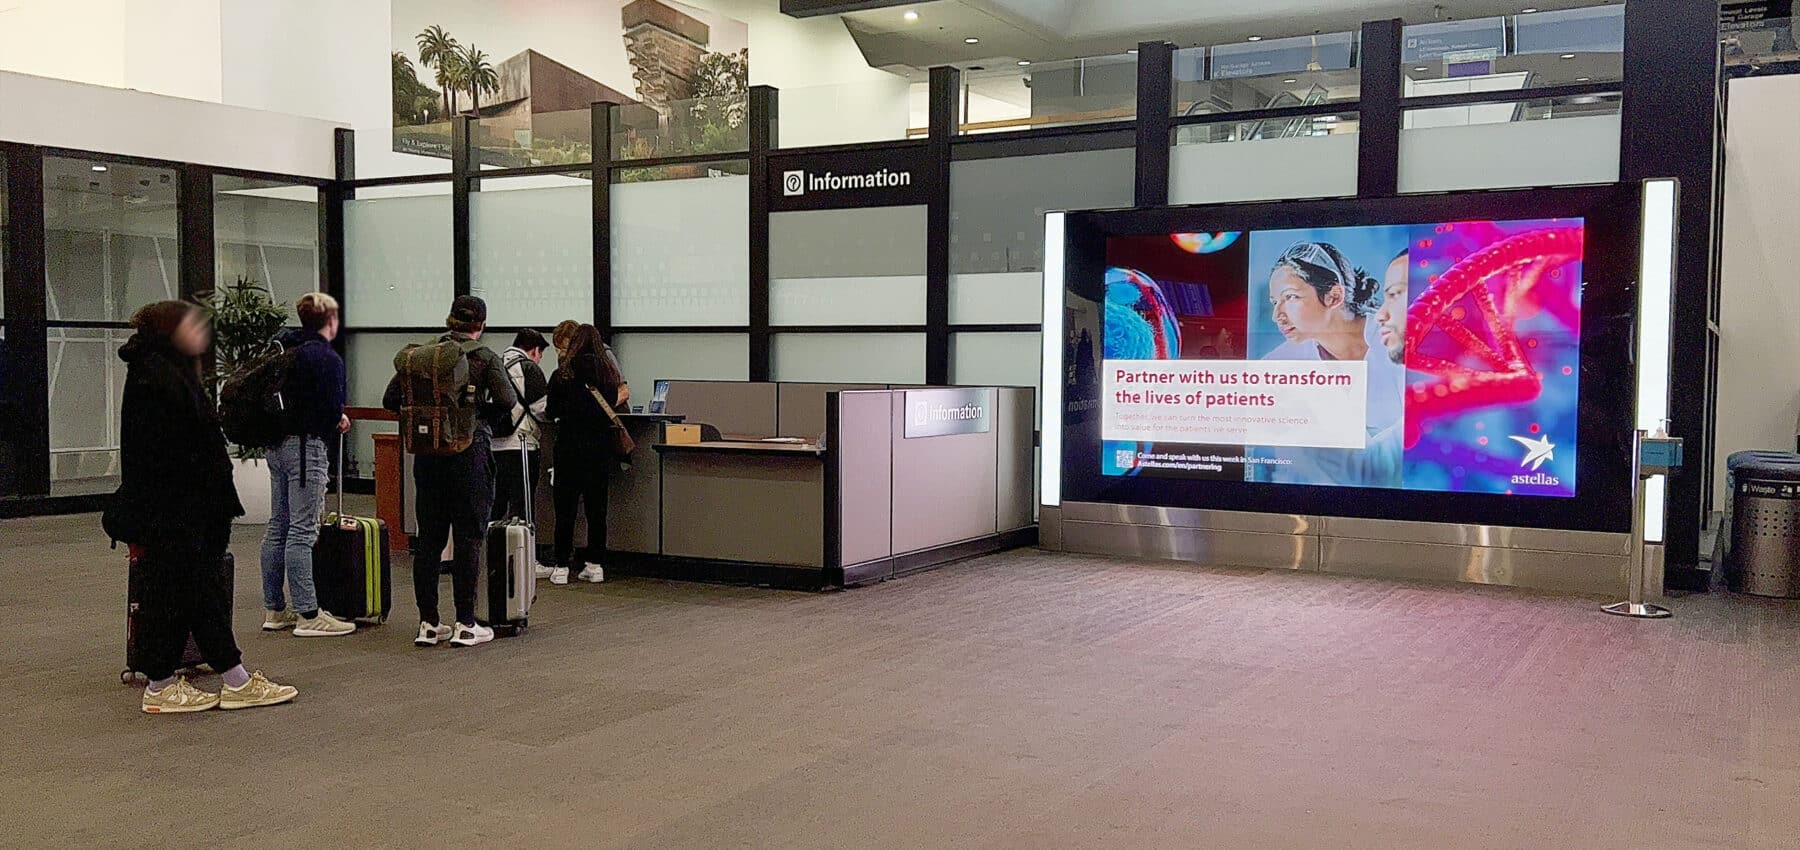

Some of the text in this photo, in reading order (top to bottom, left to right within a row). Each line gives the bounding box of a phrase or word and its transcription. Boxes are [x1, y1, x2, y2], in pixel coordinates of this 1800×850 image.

[1721, 21, 1765, 31] Elevators
[809, 169, 911, 191] Information
[1116, 370, 1352, 386] Partner with us to transform
[1115, 391, 1275, 408] the lives of patients
[929, 403, 983, 422] Information
[1197, 413, 1211, 422] the
[1212, 415, 1232, 423] most
[1234, 415, 1276, 425] innovative
[1131, 423, 1151, 431] value
[1153, 424, 1164, 432] for
[1179, 424, 1211, 434] patients
[1169, 453, 1187, 462] speak
[1247, 456, 1260, 465] San
[1260, 456, 1293, 466] Francisco:
[1137, 461, 1223, 472] Astellas.com/en/partnering
[1511, 473, 1560, 487] astellas
